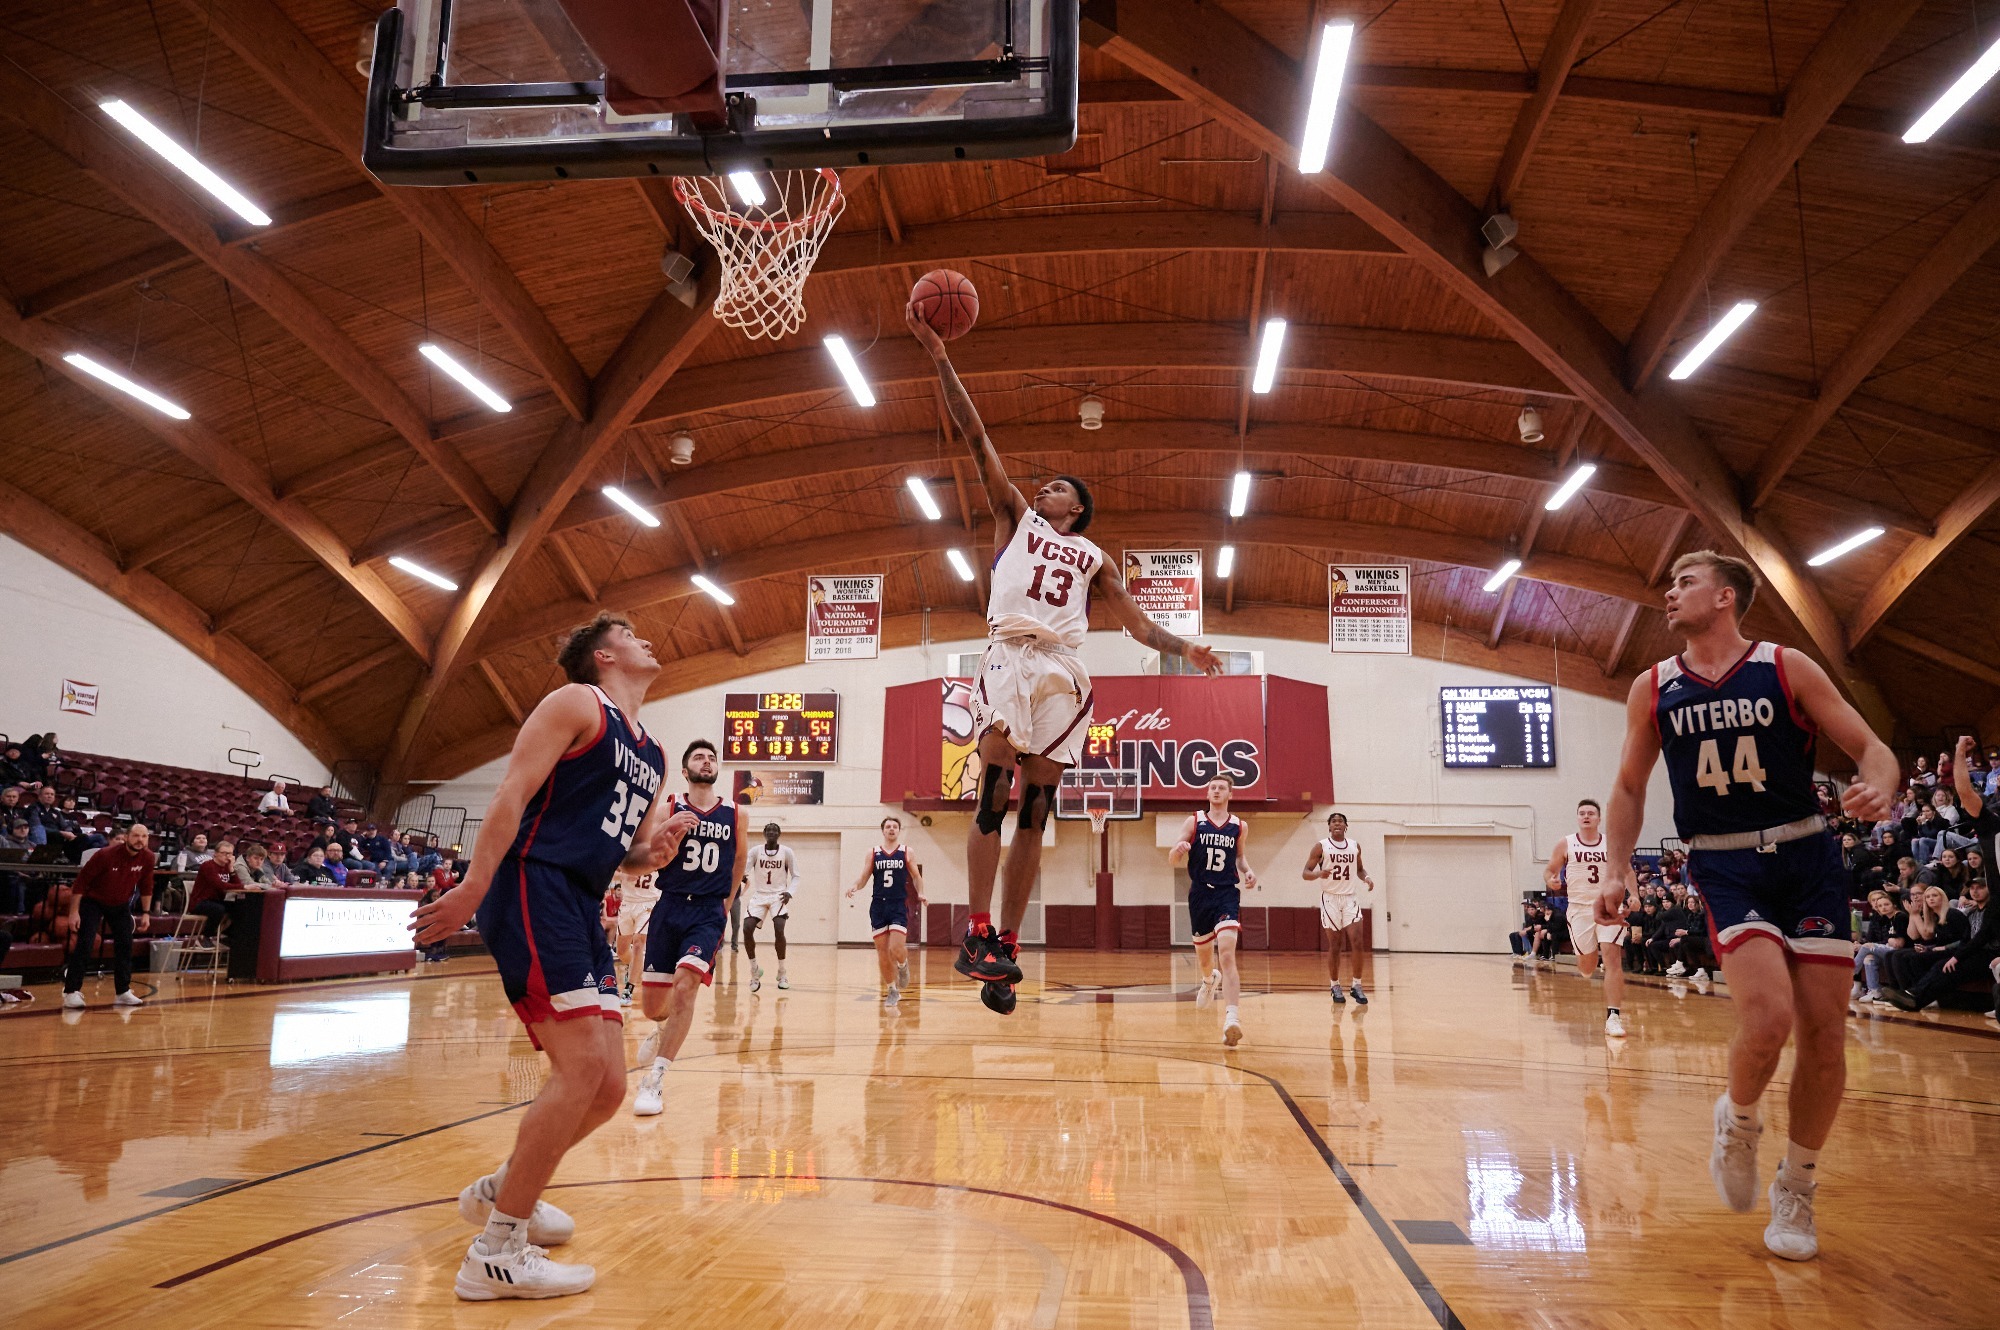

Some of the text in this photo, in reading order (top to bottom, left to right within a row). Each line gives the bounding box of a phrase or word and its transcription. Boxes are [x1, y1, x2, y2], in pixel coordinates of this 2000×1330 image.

[1027, 531, 1095, 575] VCSU
[1151, 555, 1193, 564] VIKINGS
[1355, 570, 1399, 579] VIKINGS
[833, 580, 874, 589] VIKINGS
[1026, 564, 1074, 607] 13
[1131, 594, 1194, 602] TOURNAMENT
[1341, 598, 1399, 606] CONFERENCE
[1139, 602, 1186, 610] QUALIFIER
[1333, 606, 1407, 614] CHAMPIONSHIPS
[816, 619, 875, 627] TOURNAMENT
[1459, 688, 1479, 698] THE
[1520, 688, 1549, 698] VCSU
[764, 693, 802, 710] 13:26
[726, 711, 760, 719] VIKINGS
[801, 711, 834, 719] VHAWKS
[1134, 708, 1171, 730] the
[1669, 697, 1774, 737] VITERBO
[734, 720, 754, 736] 59
[775, 721, 784, 735] 2
[810, 720, 830, 736] 54
[1088, 726, 1115, 737] 13:26
[733, 741, 758, 755] 6 6
[769, 741, 793, 755] 13 3
[800, 741, 829, 755] 5 2
[1089, 737, 1110, 754] 27
[1696, 735, 1766, 796] 44
[773, 787, 813, 795] BASKETBALL
[601, 779, 650, 852] 35
[1199, 833, 1236, 849] VITERBO
[682, 838, 720, 873] 30
[1205, 847, 1227, 872] 13
[1329, 853, 1354, 863] VCSU
[759, 859, 782, 869] VCSU
[875, 859, 904, 870] VITERBO
[766, 870, 772, 885] 1
[883, 870, 894, 888] 5
[1332, 865, 1350, 881] 24
[1587, 864, 1600, 884] 3
[634, 874, 652, 889] 12
